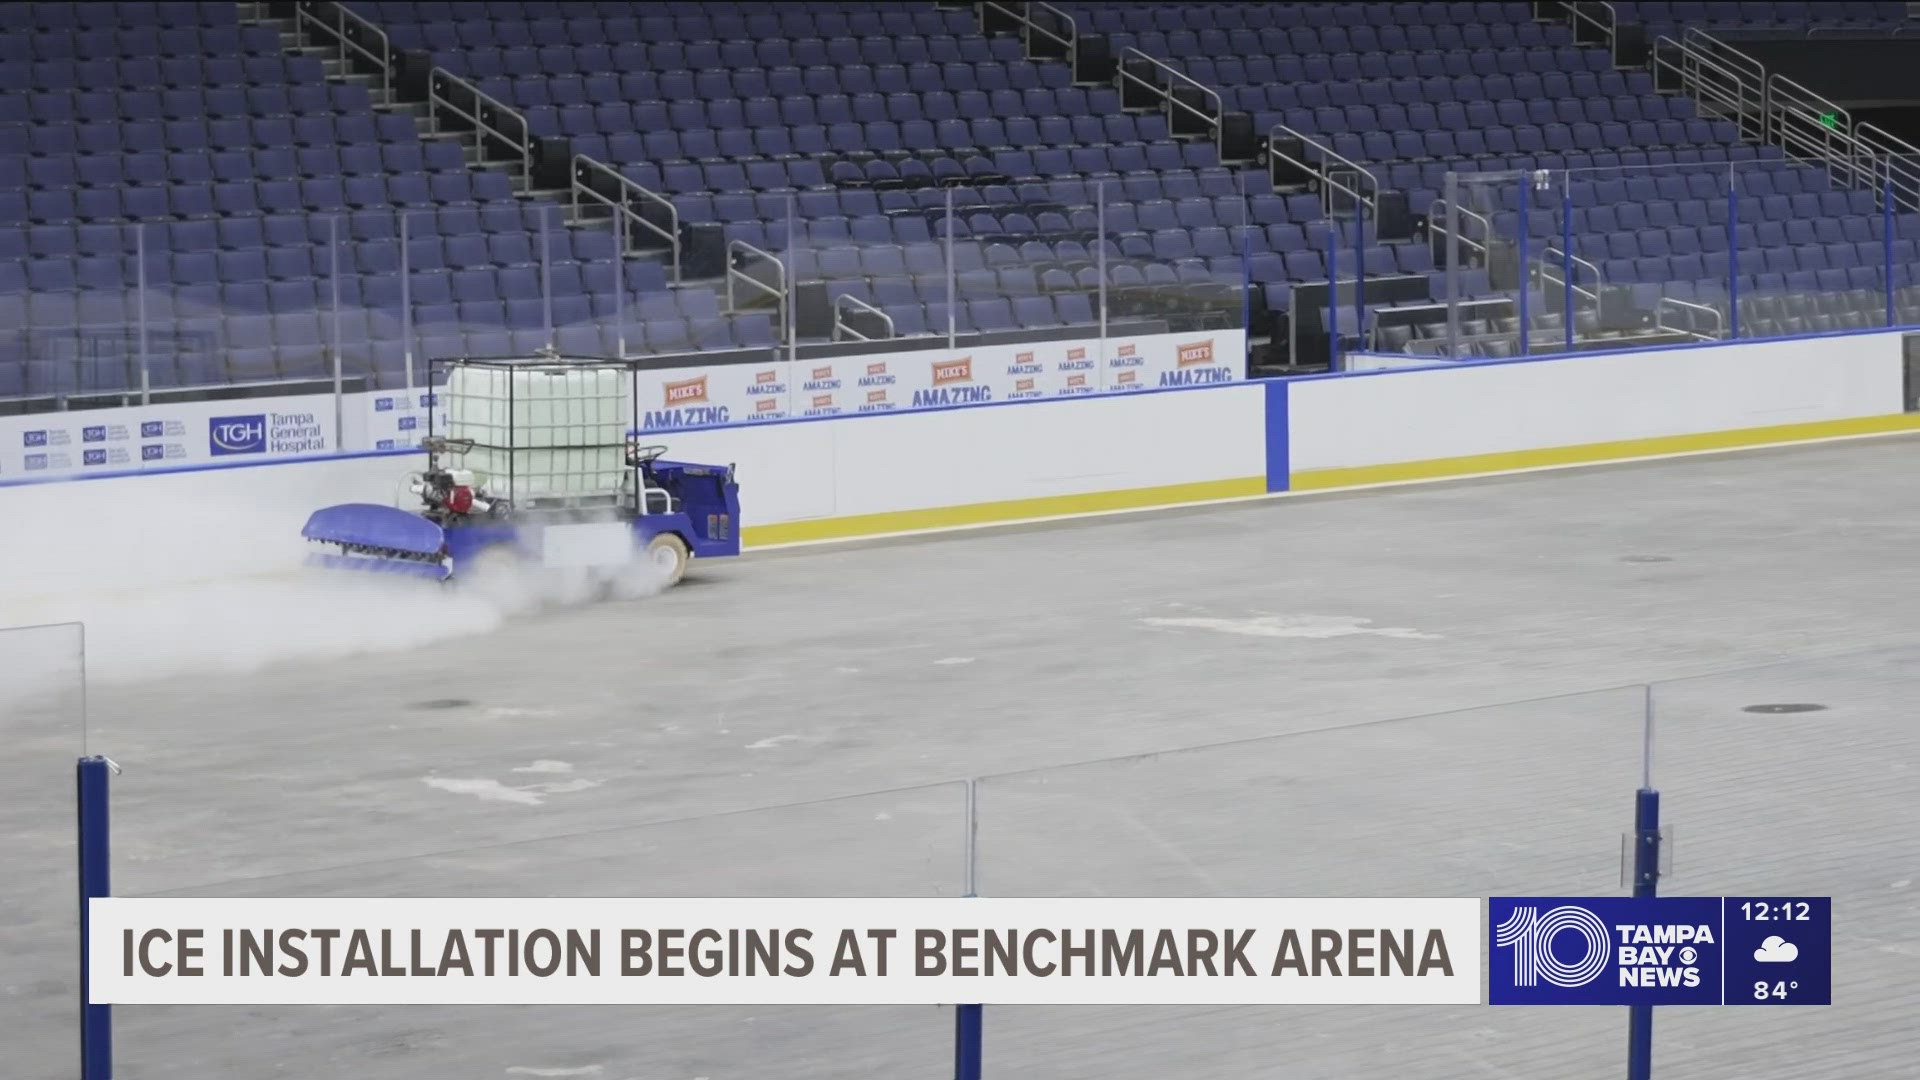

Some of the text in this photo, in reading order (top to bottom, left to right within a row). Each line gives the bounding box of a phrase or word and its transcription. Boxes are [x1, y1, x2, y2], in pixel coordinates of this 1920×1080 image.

[1181, 347, 1210, 361] MIKE'S
[936, 365, 968, 380] MIKE'S
[1007, 364, 1043, 375] AMAZING
[1159, 367, 1232, 386] AMAZING
[803, 380, 842, 391] AMAZING
[858, 375, 896, 387] AMAZING
[669, 383, 703, 400] MIKE'S
[746, 384, 786, 395] AMAZING
[912, 385, 992, 407] AMAZING
[270, 413, 314, 426] Tampa
[643, 406, 729, 429] AMAZING
[220, 422, 262, 442] TGH
[270, 425, 320, 440] General
[270, 437, 324, 453] Hospital
